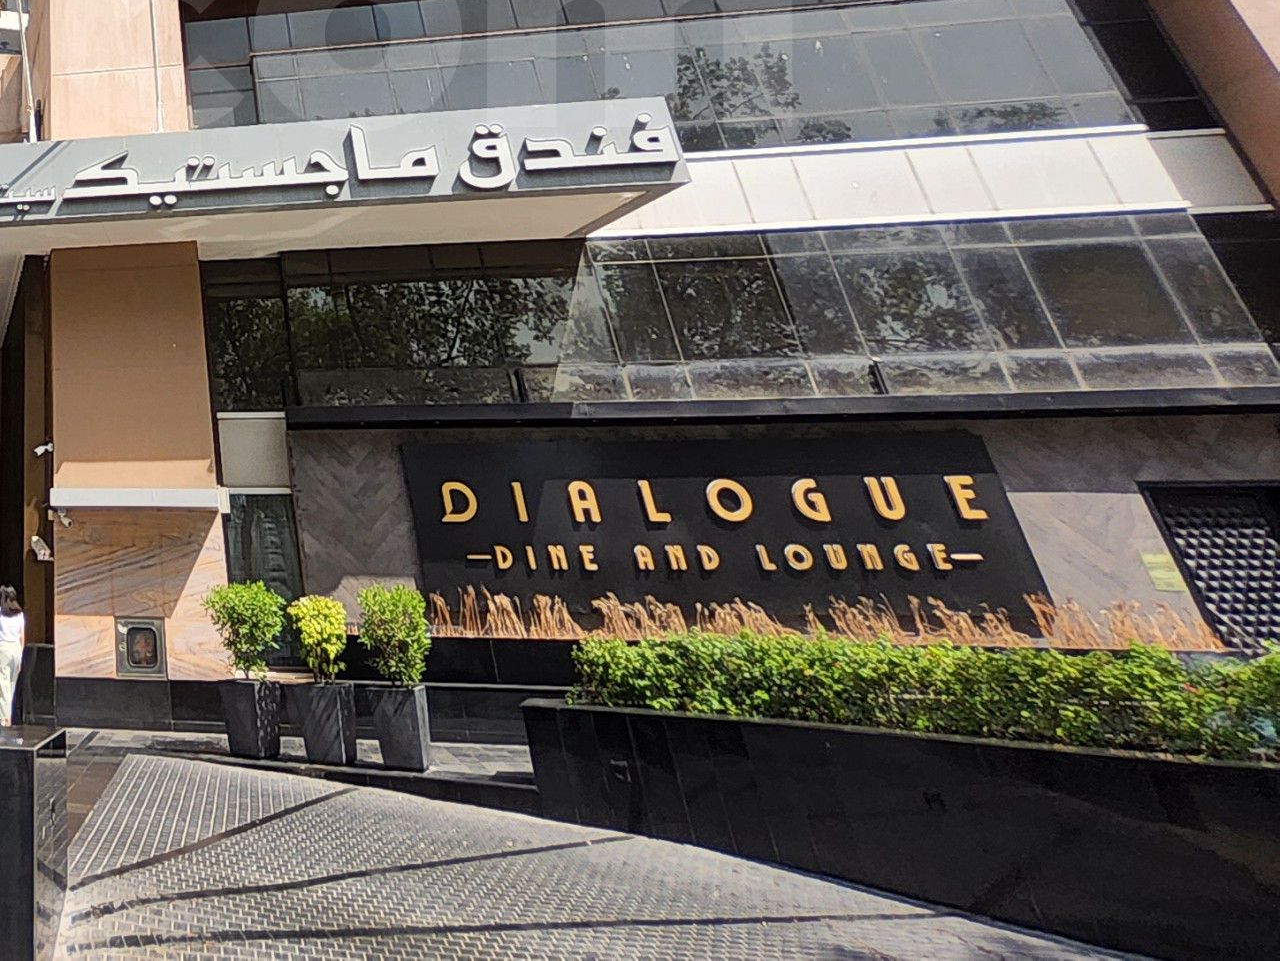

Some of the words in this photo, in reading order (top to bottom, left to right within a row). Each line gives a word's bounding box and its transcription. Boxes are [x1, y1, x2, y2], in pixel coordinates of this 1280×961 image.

[62, 123, 440, 206] ماجستيك
[459, 112, 680, 189] فندق
[441, 475, 988, 523] DIALOGUE
[494, 544, 599, 571] DINE
[633, 544, 720, 571] AND
[755, 542, 954, 571] LOUNGE
